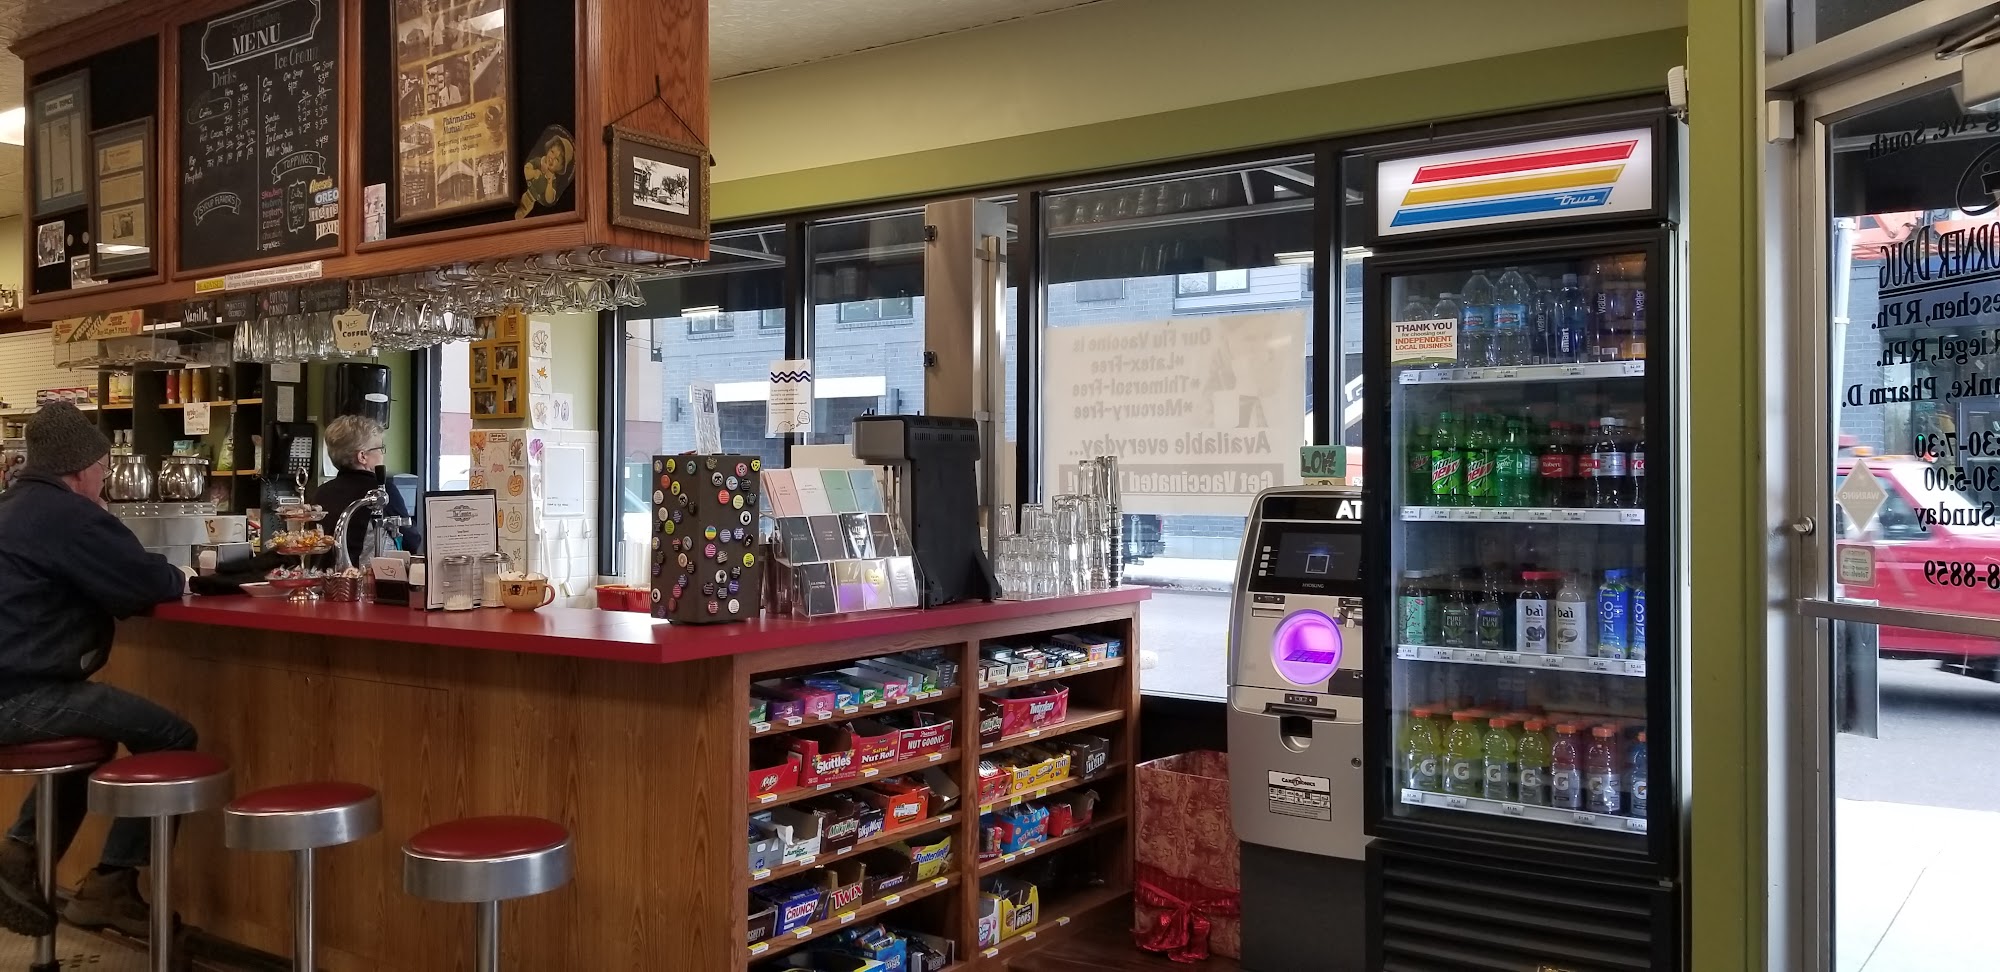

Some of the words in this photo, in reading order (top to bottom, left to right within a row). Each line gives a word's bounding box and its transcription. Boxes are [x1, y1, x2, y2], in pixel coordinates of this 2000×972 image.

[232, 23, 280, 56] MENU
[274, 53, 288, 69] Ice
[290, 47, 318, 65] Cream
[212, 68, 237, 89] Drinks
[443, 112, 476, 126] Pharmacists
[443, 125, 462, 135] Mutual
[283, 154, 313, 169] TOPPINGS
[315, 188, 339, 205] OREO
[1554, 194, 1599, 205] true
[269, 291, 288, 303] COTTON
[1597, 292, 1606, 314] water
[1635, 290, 1644, 311] water
[184, 307, 208, 323] Vanilla
[269, 303, 288, 316] CANDY
[342, 330, 367, 338] COFFEE
[1395, 323, 1431, 332] THANK
[1432, 322, 1453, 330] YOU
[1395, 335, 1453, 344] INDEPENDENT
[1561, 328, 1569, 353] smart
[1604, 601, 1614, 632] ZICO
[1636, 603, 1644, 635] ZICO
[1053, 639, 1088, 654] mentos
[907, 740, 921, 750] NUT
[921, 734, 944, 747] GOODIES
[861, 754, 878, 763] Nut
[879, 749, 895, 760] Roll
[816, 756, 851, 775] Skittles
[1420, 759, 1436, 776] G
[1453, 762, 1470, 780] G
[1485, 765, 1501, 782] G
[1521, 769, 1536, 787] G
[1553, 772, 1568, 790] G
[1588, 777, 1602, 794] G
[785, 847, 805, 857] Junior
[916, 844, 950, 864] Butterfinger
[785, 901, 816, 921] CRUNCH
[1017, 910, 1031, 927] POPS
